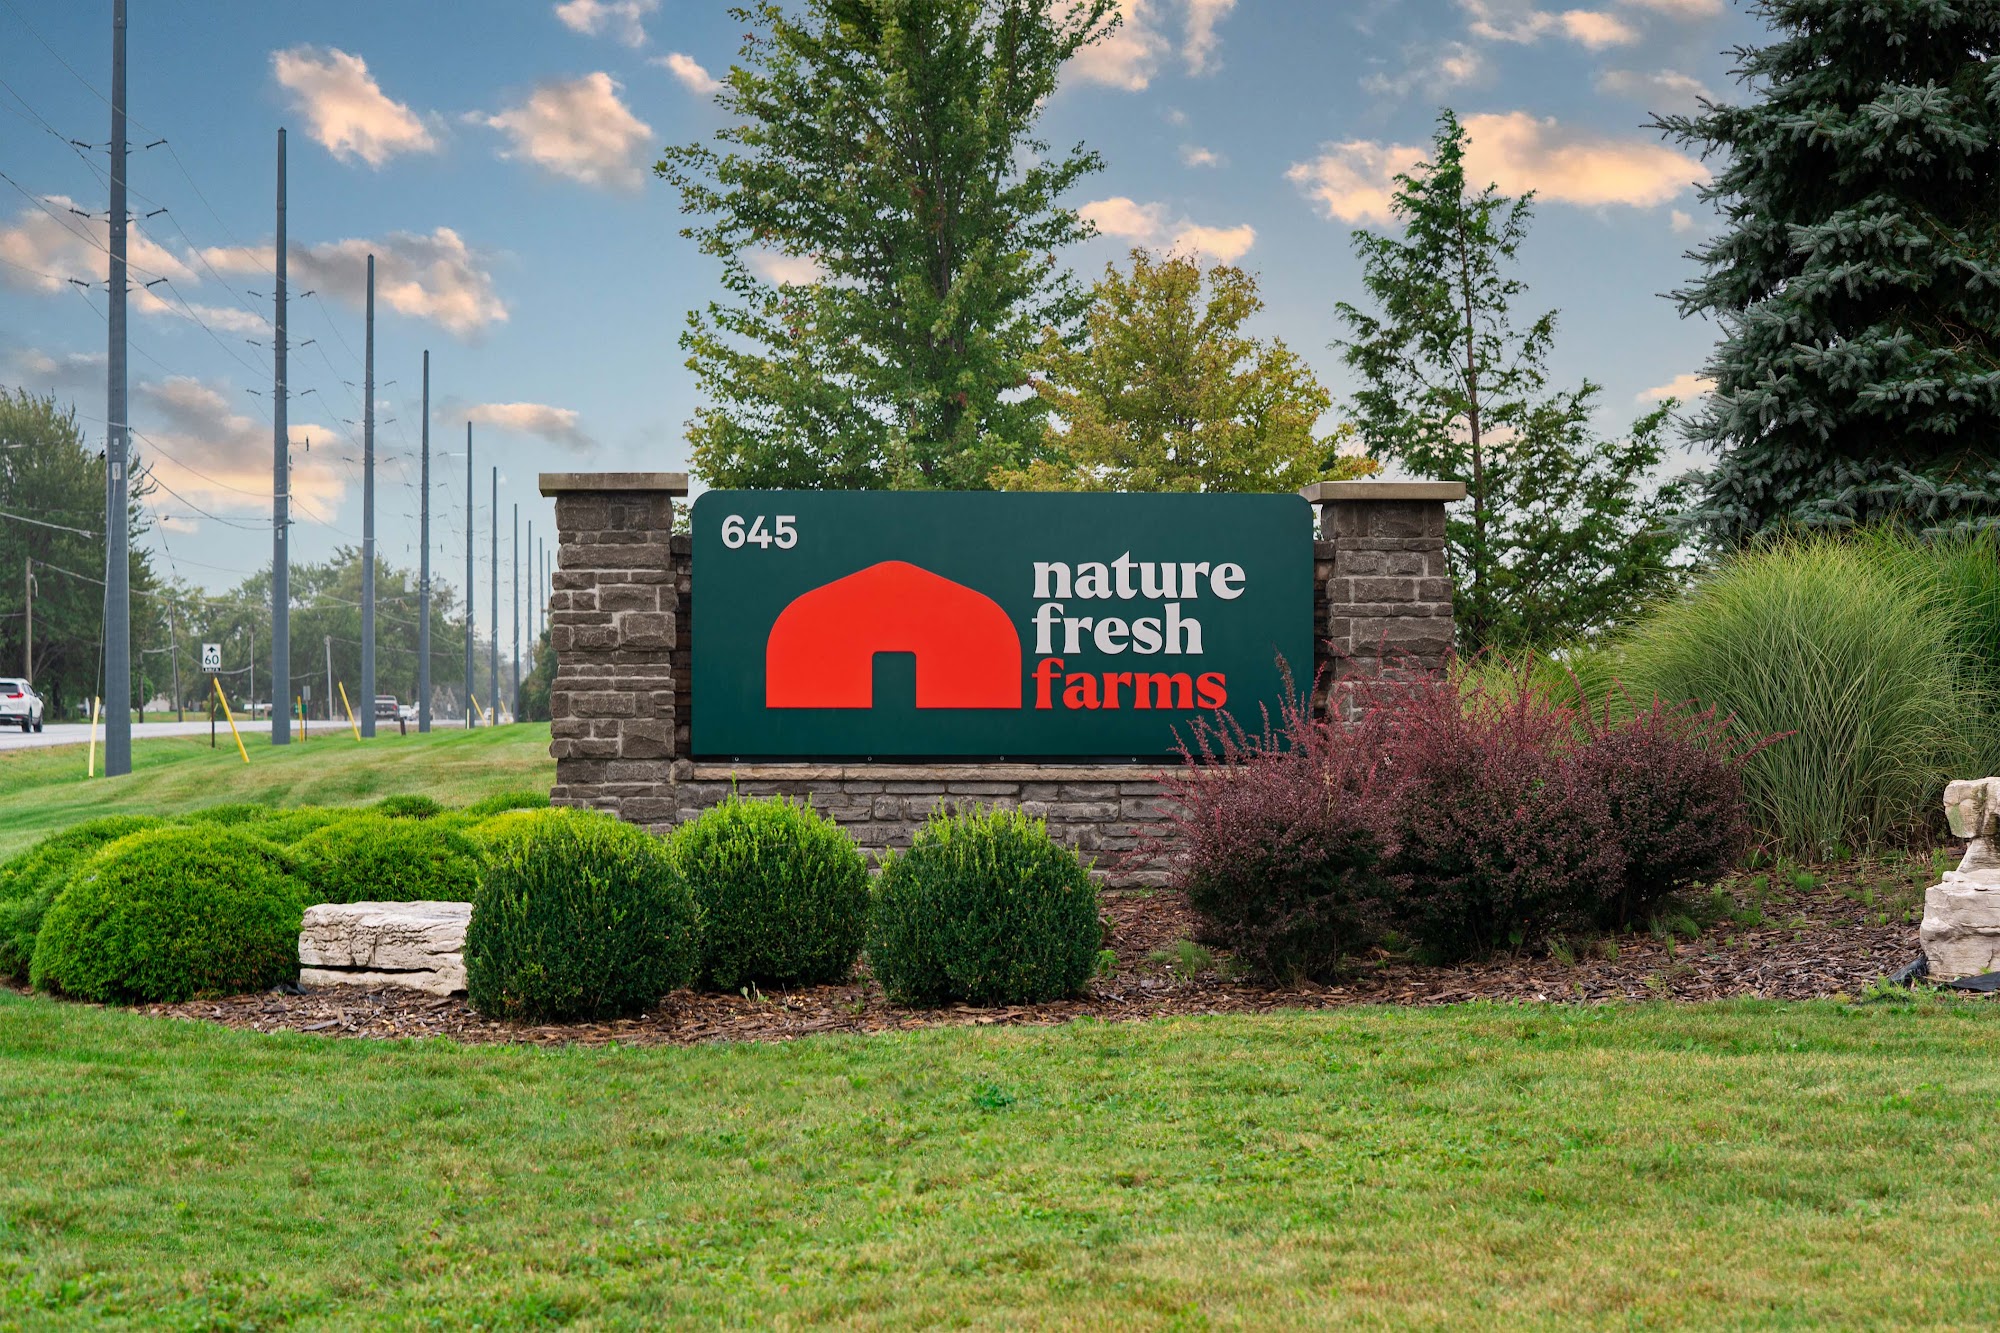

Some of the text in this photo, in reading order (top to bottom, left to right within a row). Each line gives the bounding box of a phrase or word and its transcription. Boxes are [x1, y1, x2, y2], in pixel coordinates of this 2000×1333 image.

[722, 515, 798, 549] 645
[1032, 550, 1246, 600] nature
[1031, 603, 1204, 655] fresh
[205, 654, 219, 665] 60
[1031, 657, 1228, 710] farms
